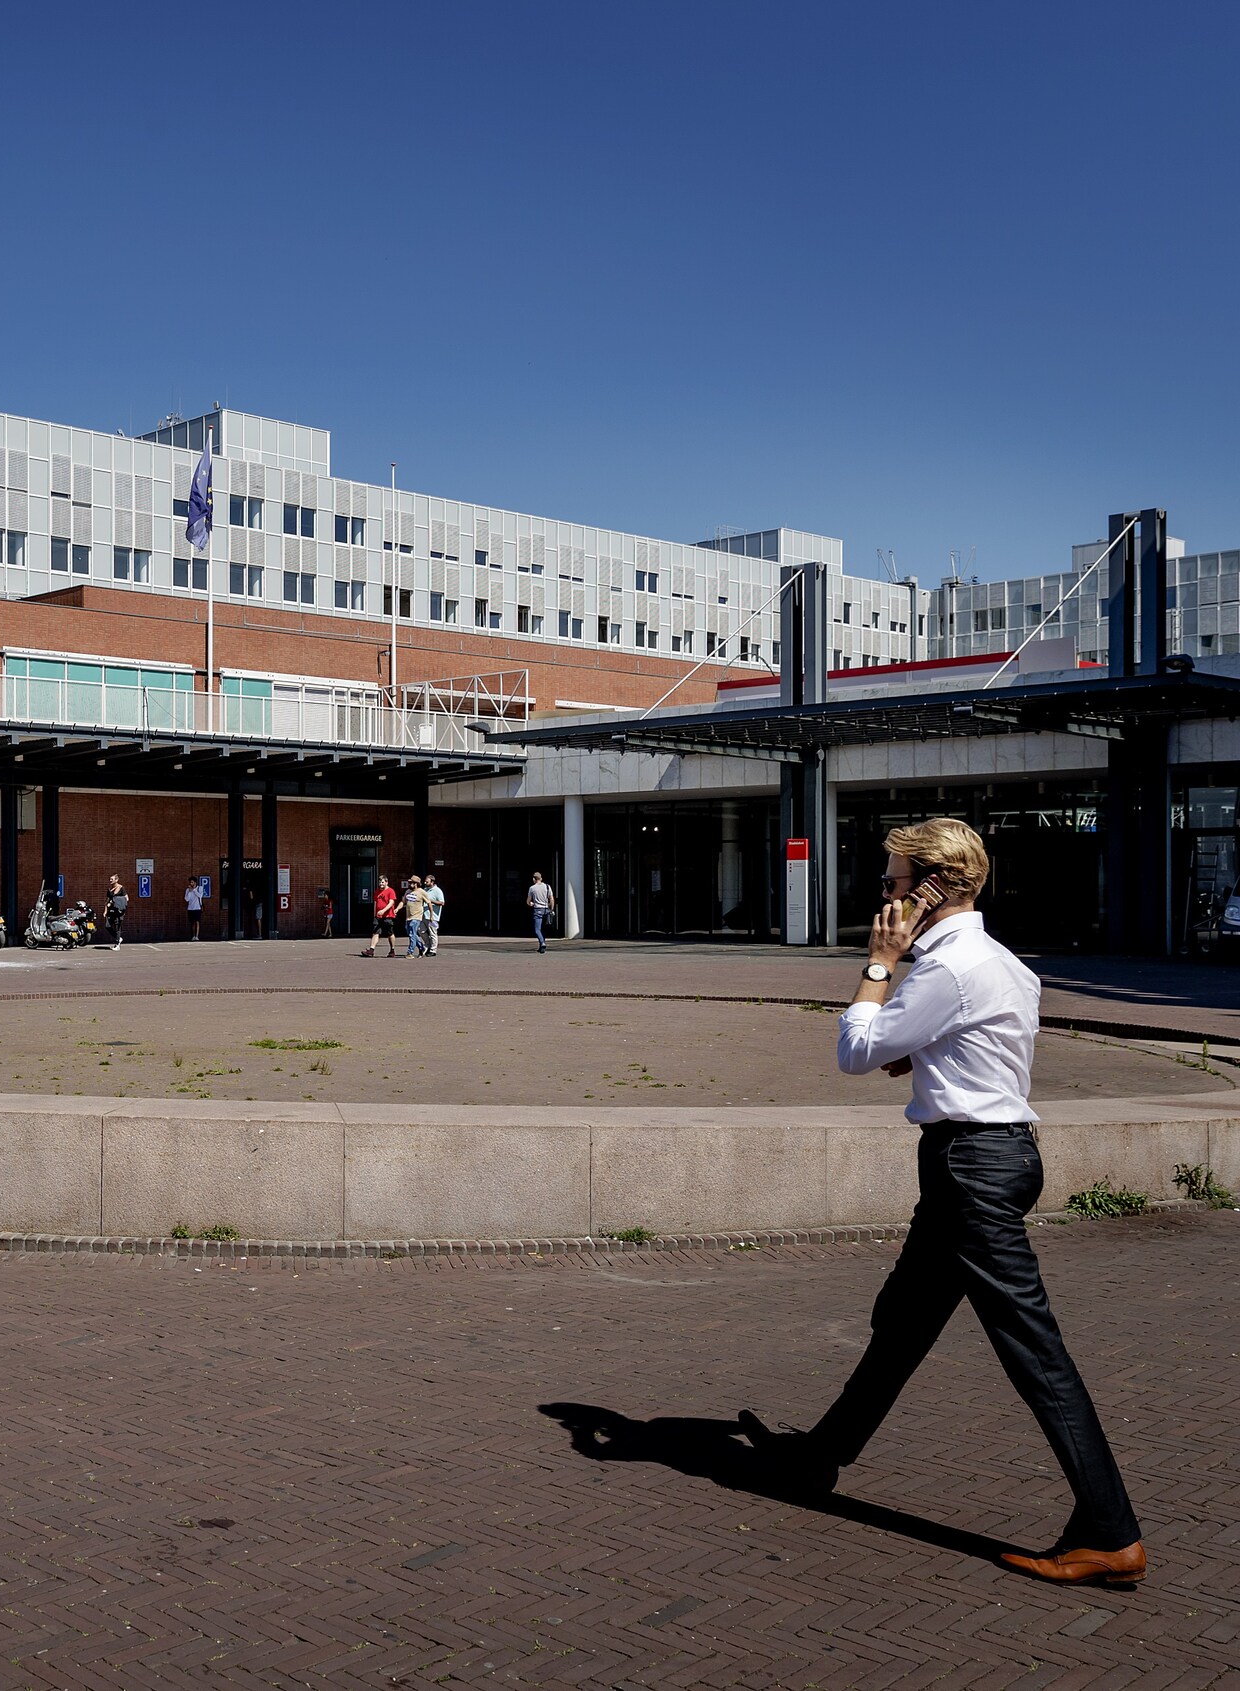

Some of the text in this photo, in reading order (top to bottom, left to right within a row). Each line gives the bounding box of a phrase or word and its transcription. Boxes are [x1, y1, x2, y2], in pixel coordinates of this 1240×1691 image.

[335, 834, 383, 842] PARKEERGARAGE
[141, 877, 148, 888] P
[202, 878, 208, 888] P
[280, 896, 289, 909] B
